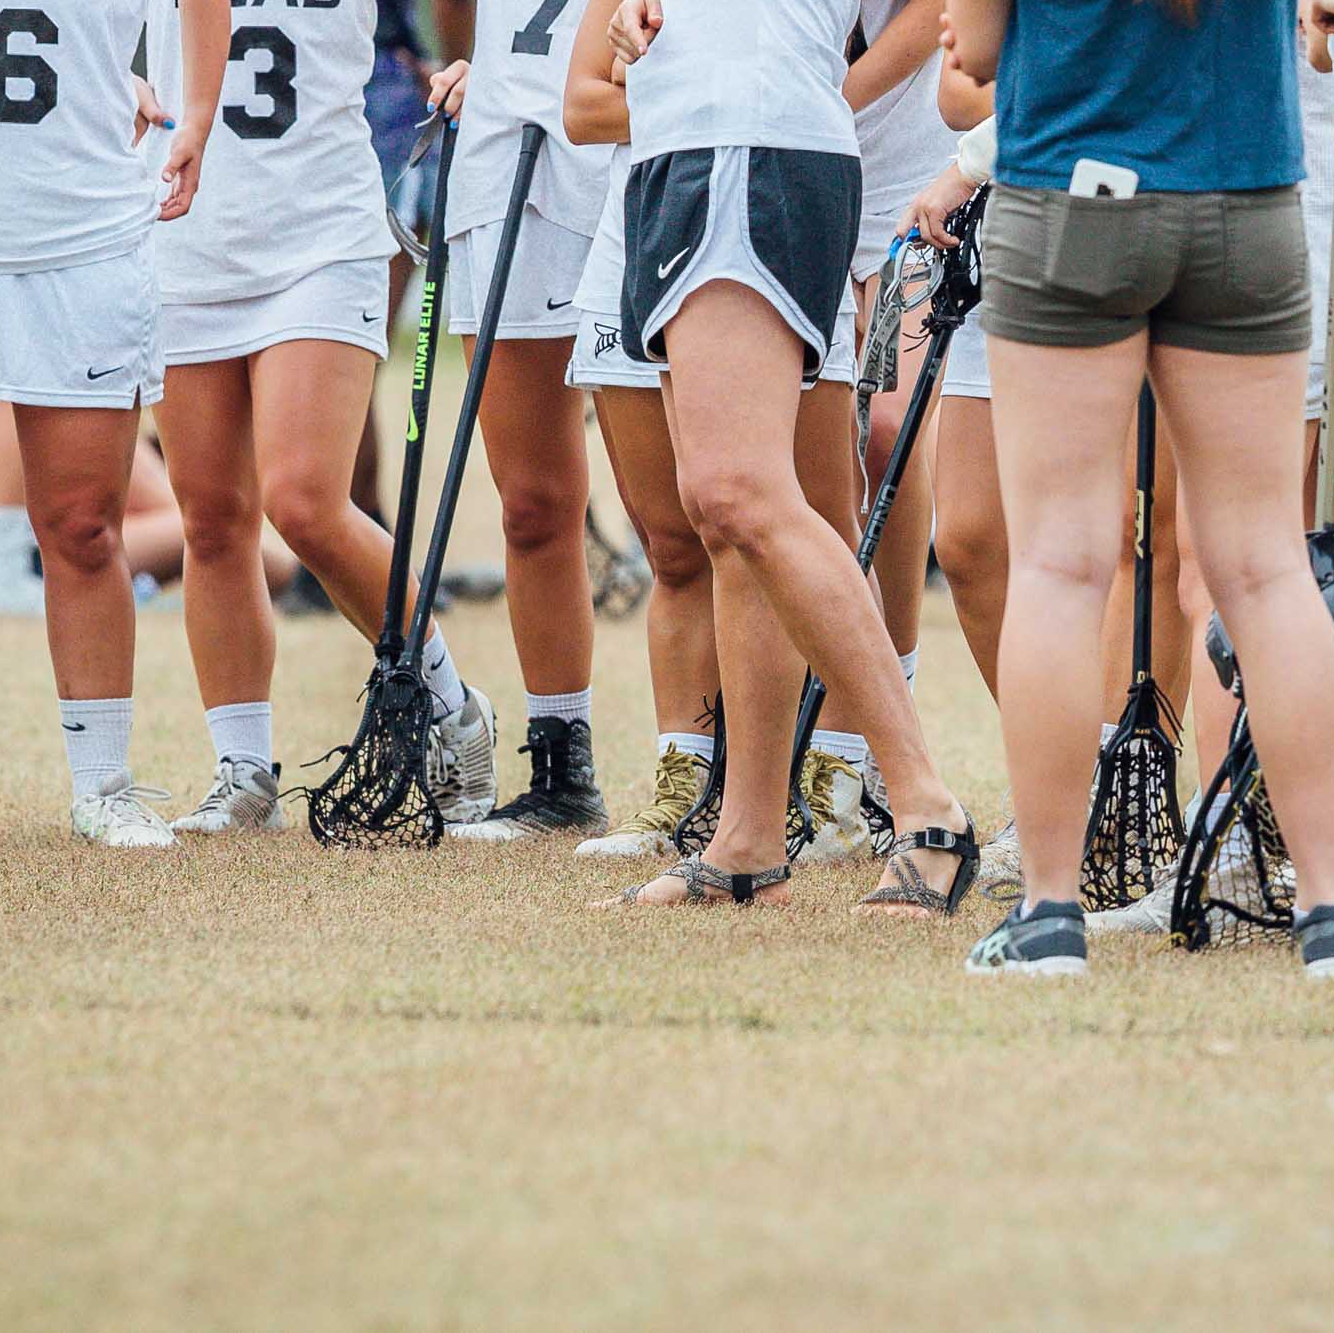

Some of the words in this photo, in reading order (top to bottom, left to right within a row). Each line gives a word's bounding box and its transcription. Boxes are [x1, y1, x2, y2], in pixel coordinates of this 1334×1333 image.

[222, 26, 297, 139] 3
[419, 281, 436, 328] ELITE
[413, 331, 430, 391] LUNAR
